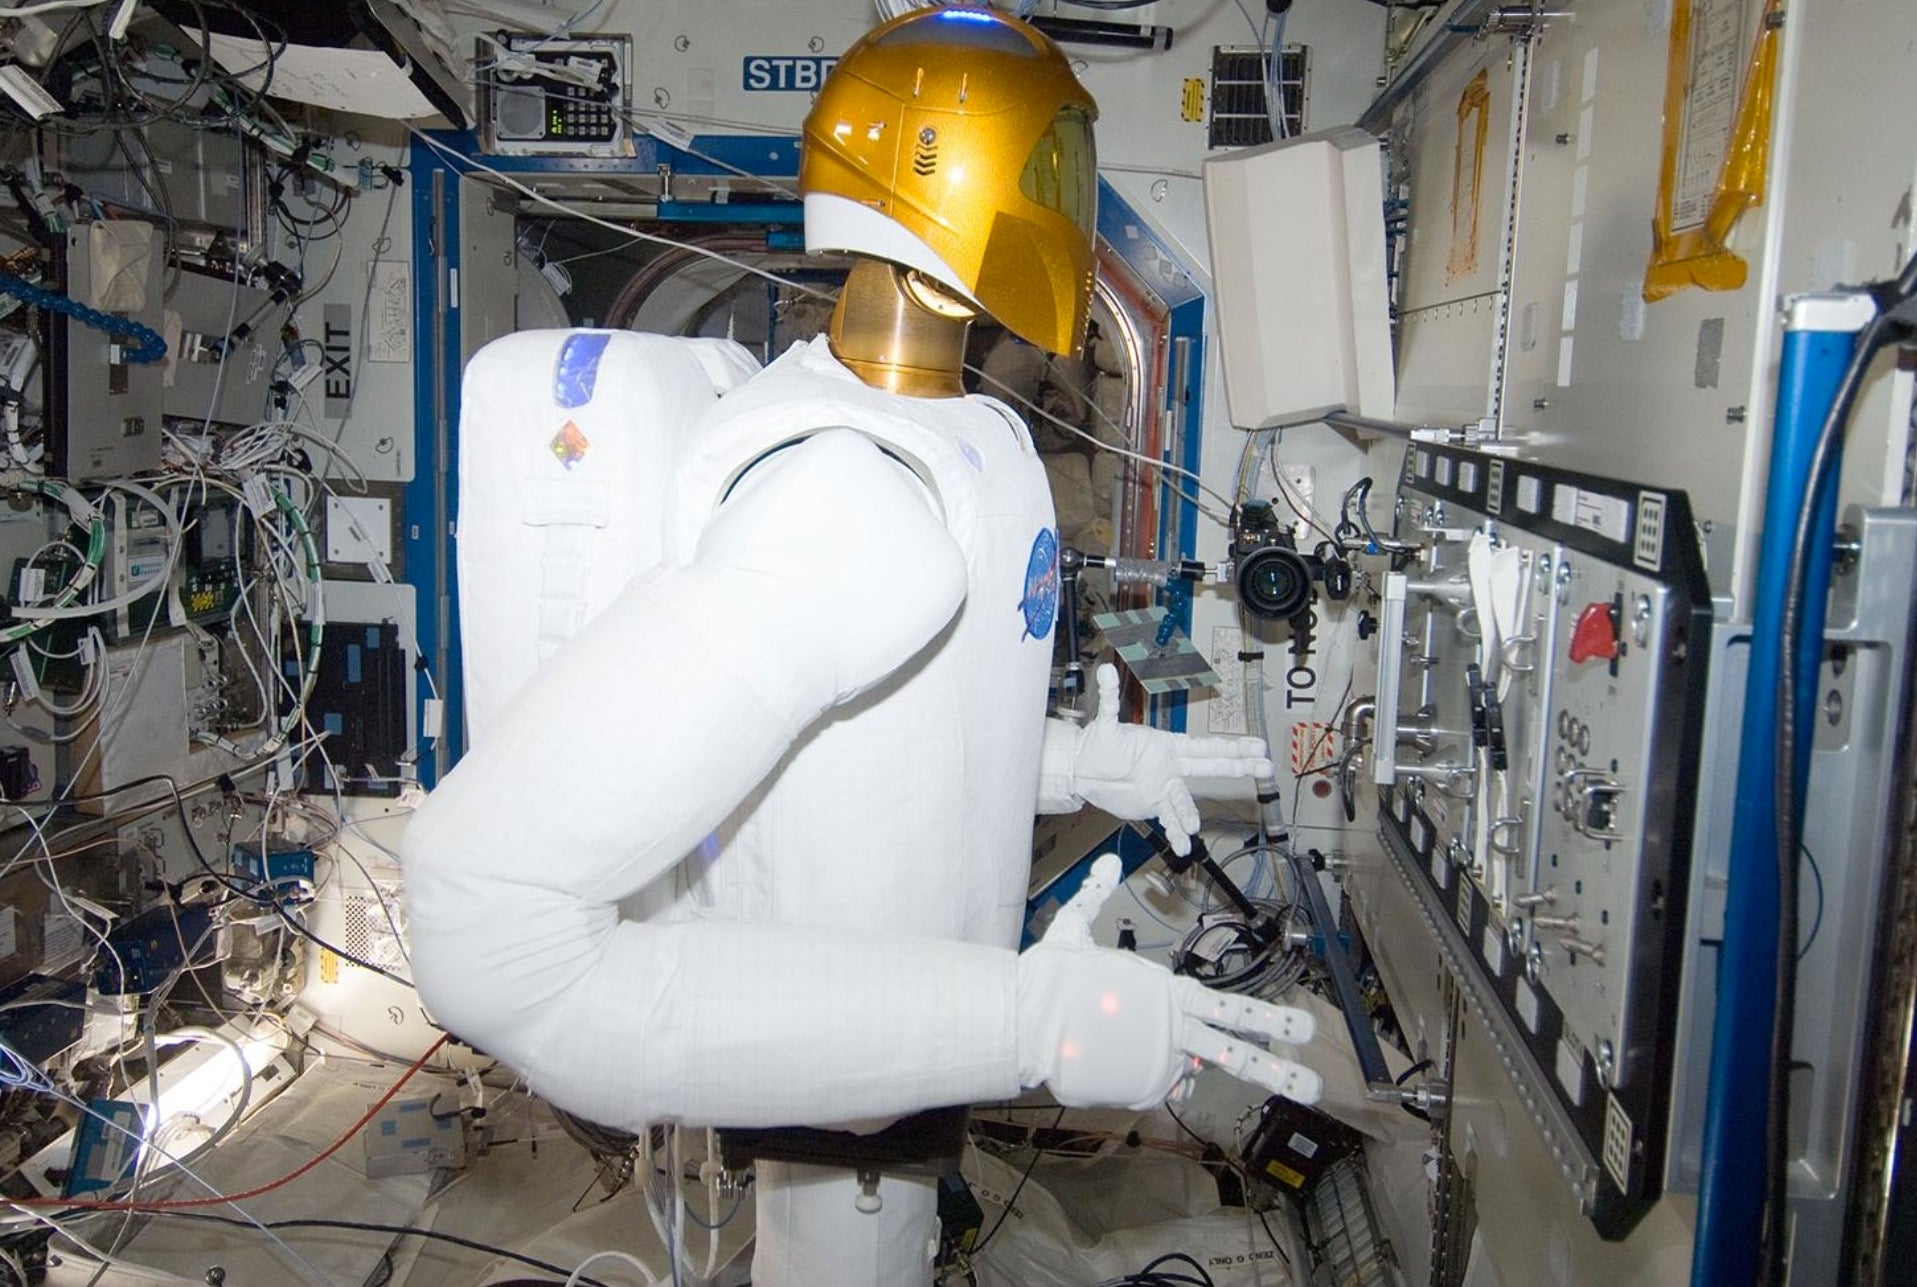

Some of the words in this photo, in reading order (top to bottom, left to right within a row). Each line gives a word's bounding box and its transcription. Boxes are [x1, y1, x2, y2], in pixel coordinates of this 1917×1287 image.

[325, 322, 350, 399] EXIT
[1287, 587, 1318, 655] NO
[1286, 666, 1316, 709] TO
[1208, 1256, 1232, 1266] ONLY
